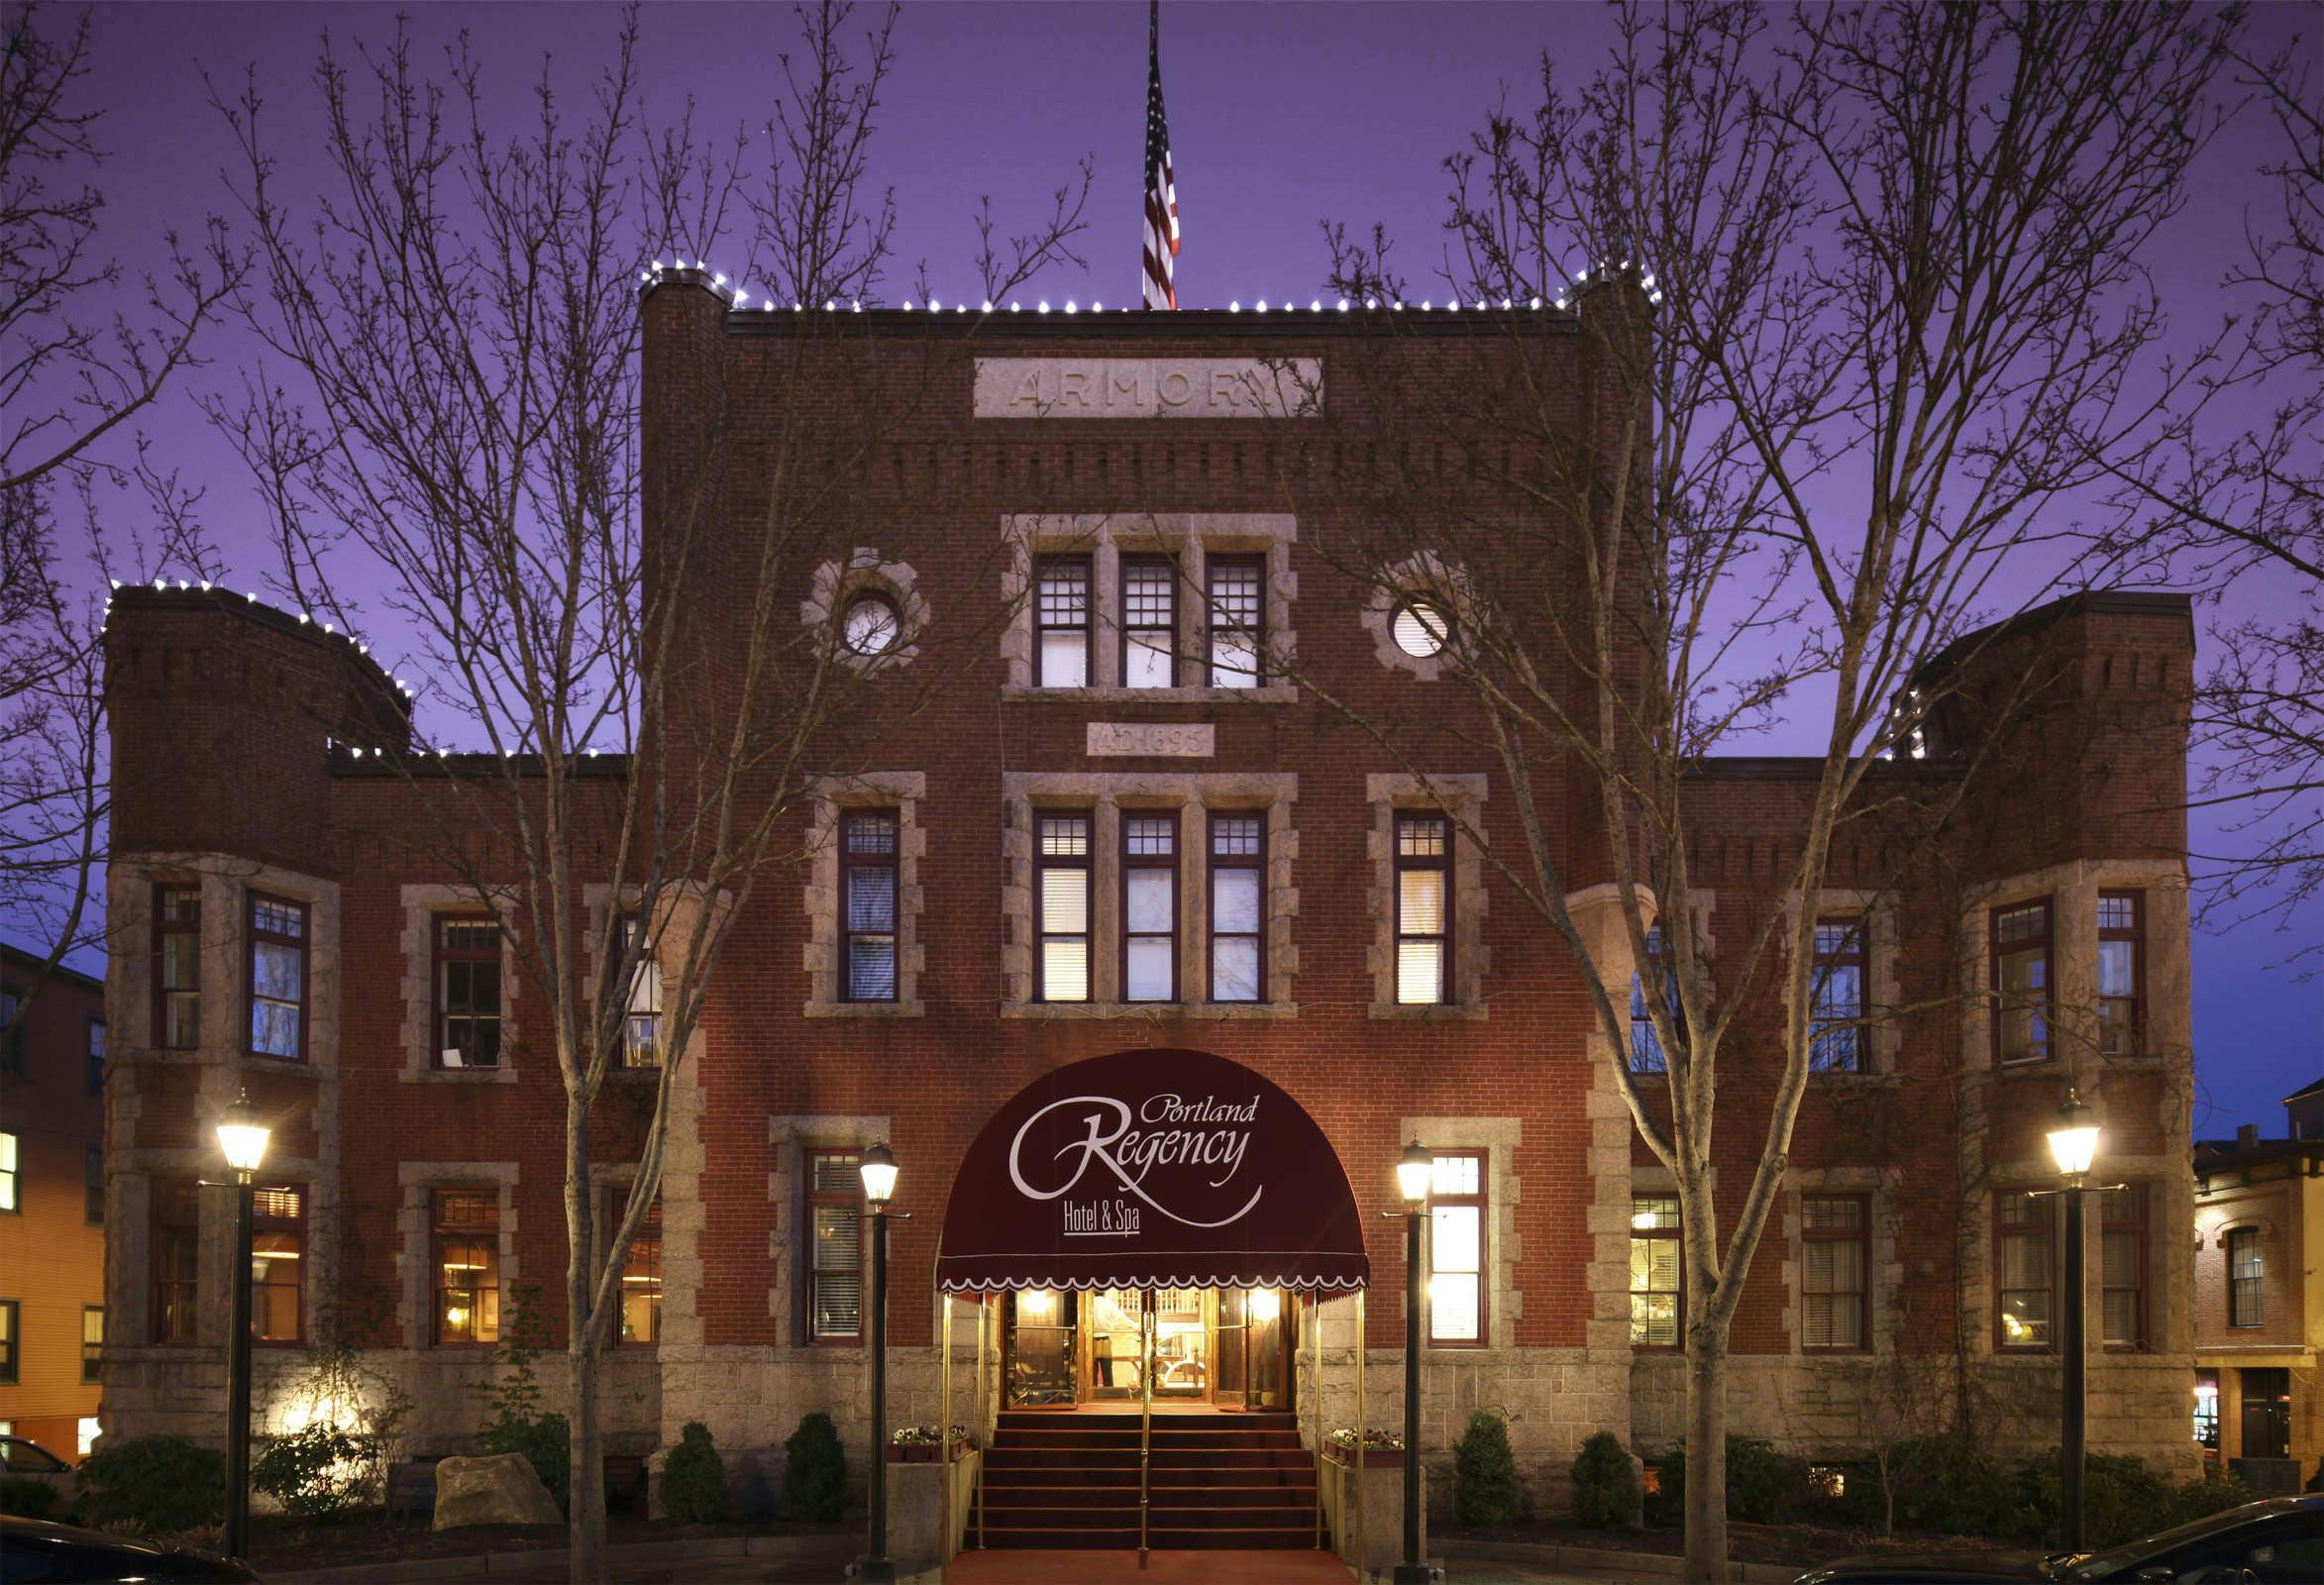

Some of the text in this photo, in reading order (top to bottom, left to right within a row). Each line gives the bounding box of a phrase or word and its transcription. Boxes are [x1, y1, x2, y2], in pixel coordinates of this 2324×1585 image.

[1009, 368, 1285, 407] ARMORY
[1140, 1094, 1260, 1123] Portland
[1008, 1096, 1262, 1227] Regency
[1064, 1200, 1140, 1237] Hotel & Spa
